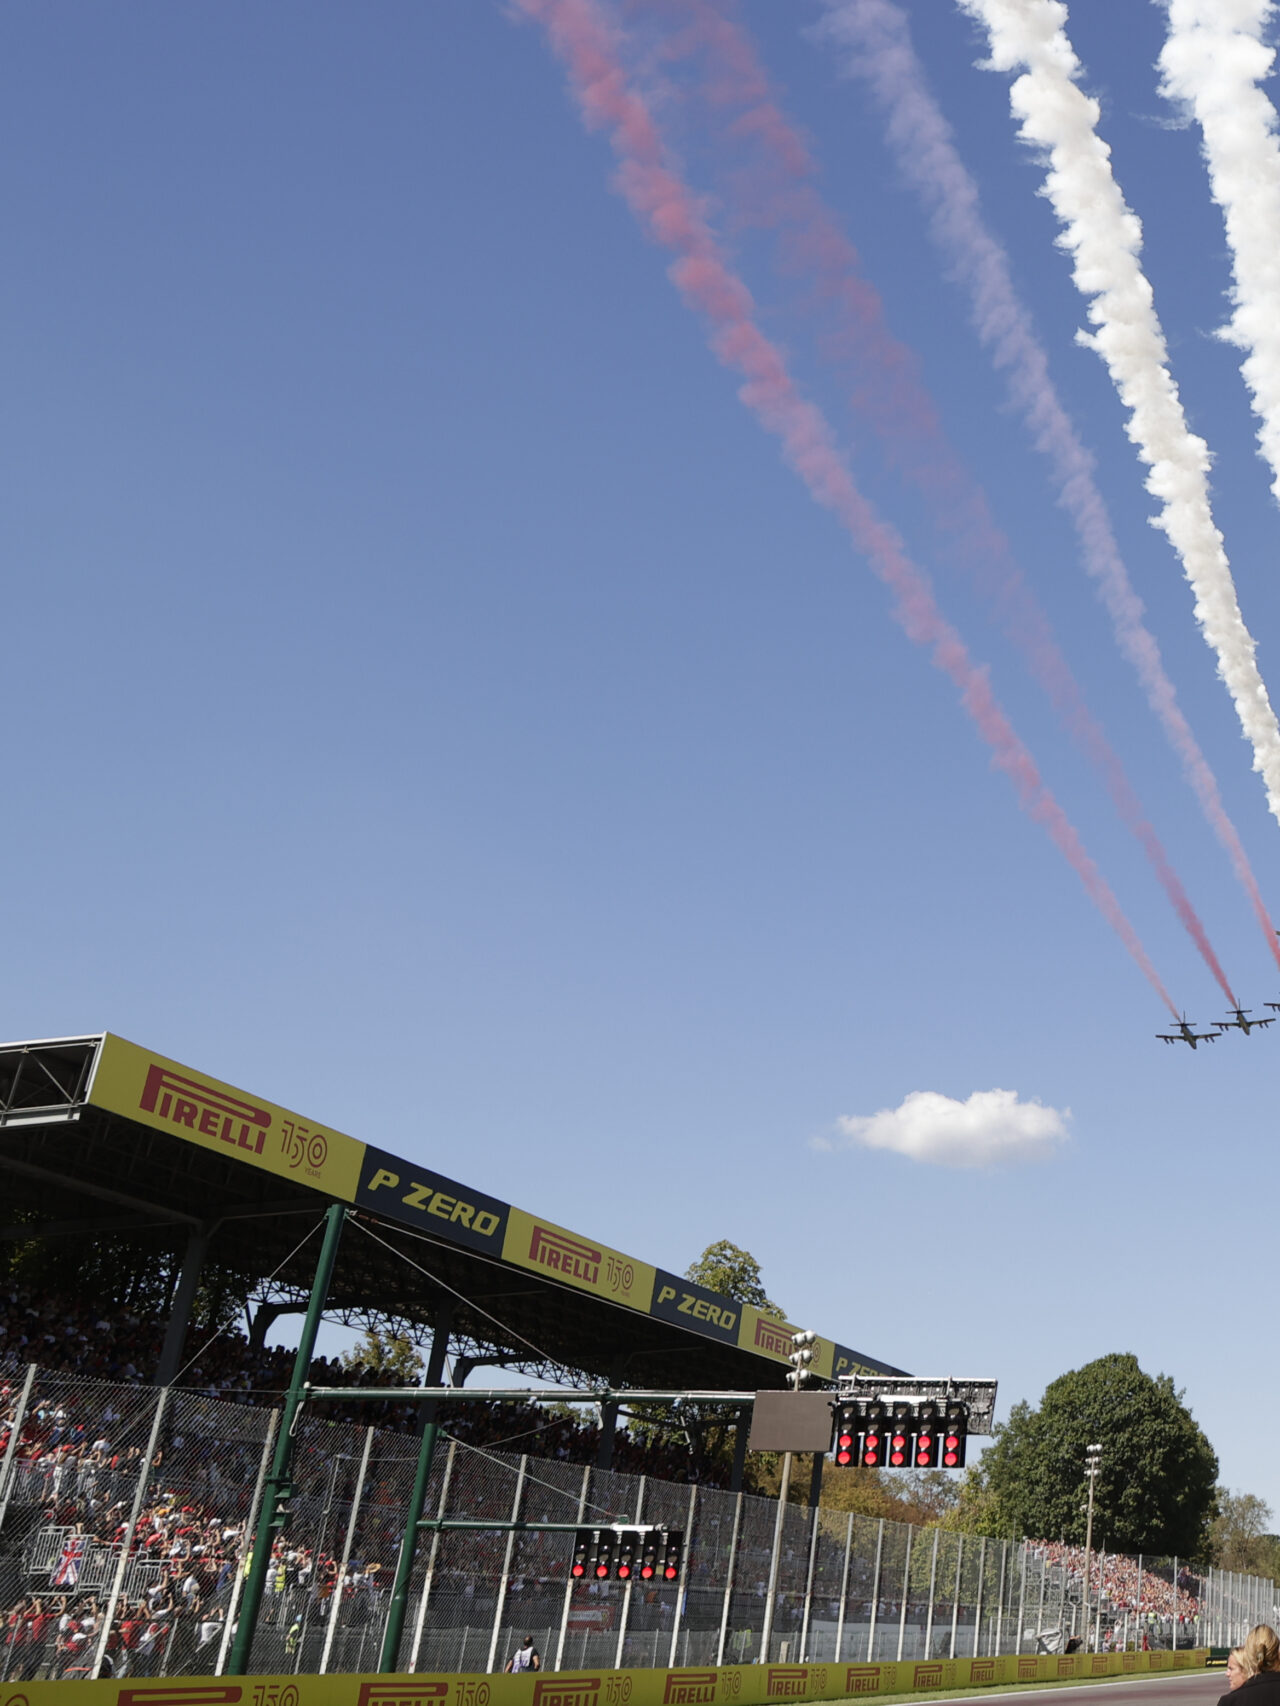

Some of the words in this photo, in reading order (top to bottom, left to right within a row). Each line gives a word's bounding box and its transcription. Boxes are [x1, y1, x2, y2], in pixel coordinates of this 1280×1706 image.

[139, 1063, 272, 1155] PIRELLI
[281, 1120, 328, 1168] 150
[368, 1168, 400, 1191] P
[402, 1182, 500, 1237] ZERO
[528, 1225, 602, 1285] PIRELLI
[607, 1256, 634, 1292] 150
[657, 1285, 676, 1304] P
[677, 1293, 736, 1331] ZERO
[836, 1357, 848, 1372] P
[849, 1362, 888, 1376] ZE
[606, 1676, 633, 1706] 150
[663, 1673, 717, 1704] PIRELLI
[767, 1668, 808, 1696] PIRELLI
[845, 1667, 880, 1693] PIRELLI
